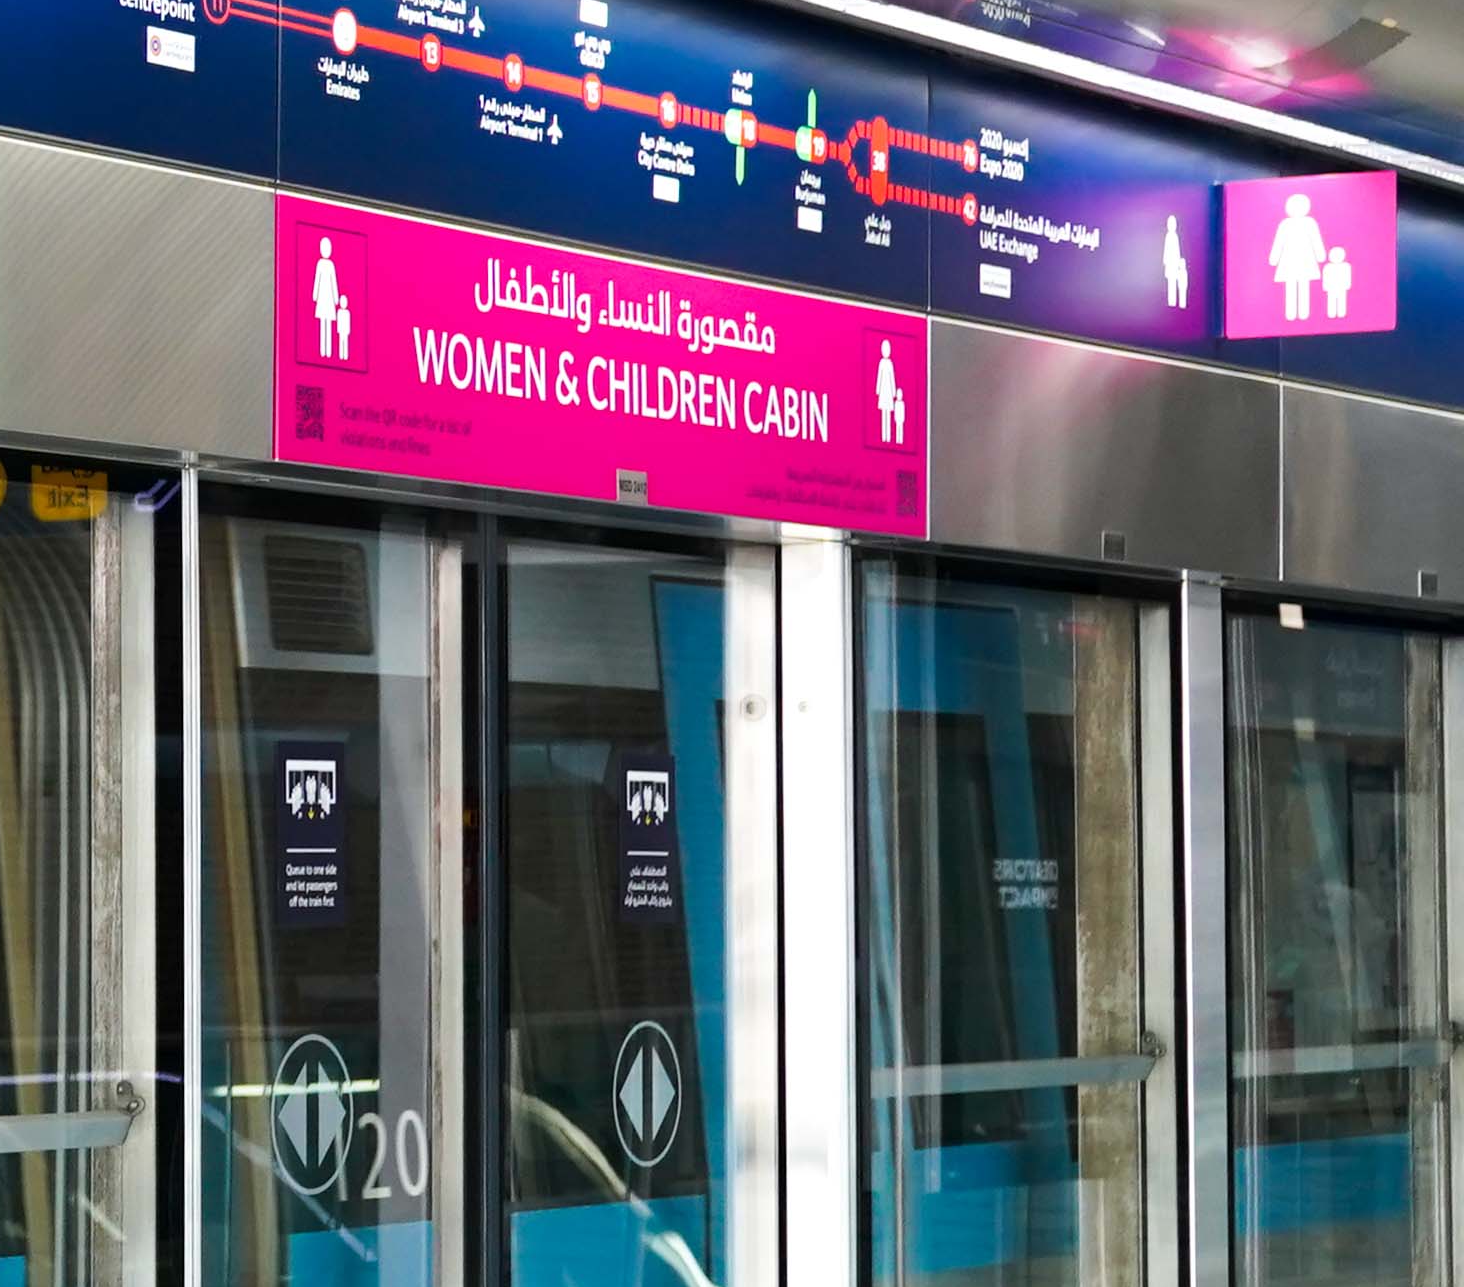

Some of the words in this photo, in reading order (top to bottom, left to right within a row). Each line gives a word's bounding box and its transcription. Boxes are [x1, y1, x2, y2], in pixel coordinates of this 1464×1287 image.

[423, 41, 439, 65] 13
[325, 79, 361, 102] Emirates
[813, 136, 826, 158] 19
[979, 127, 1003, 151] 2020
[963, 144, 976, 167] 76
[979, 152, 1002, 180] Expo
[1002, 160, 1025, 182] 2020
[962, 199, 977, 221] 42
[979, 229, 998, 251] UAE
[998, 232, 1039, 265] Exchange
[474, 256, 593, 334] والأطفال
[598, 279, 672, 339] النساء
[676, 301, 776, 355] مقصورة
[413, 326, 547, 404] WOMEN
[555, 350, 582, 406] &
[586, 355, 737, 428] CHILDREN
[742, 381, 830, 444] CABIN
[285, 863, 306, 877] Queue
[306, 864, 313, 876] to
[313, 865, 325, 876] one
[325, 863, 337, 876] side
[285, 880, 298, 892] and
[298, 880, 306, 892] let
[305, 881, 338, 895] passengers
[298, 895, 308, 908] the
[308, 895, 323, 908] train
